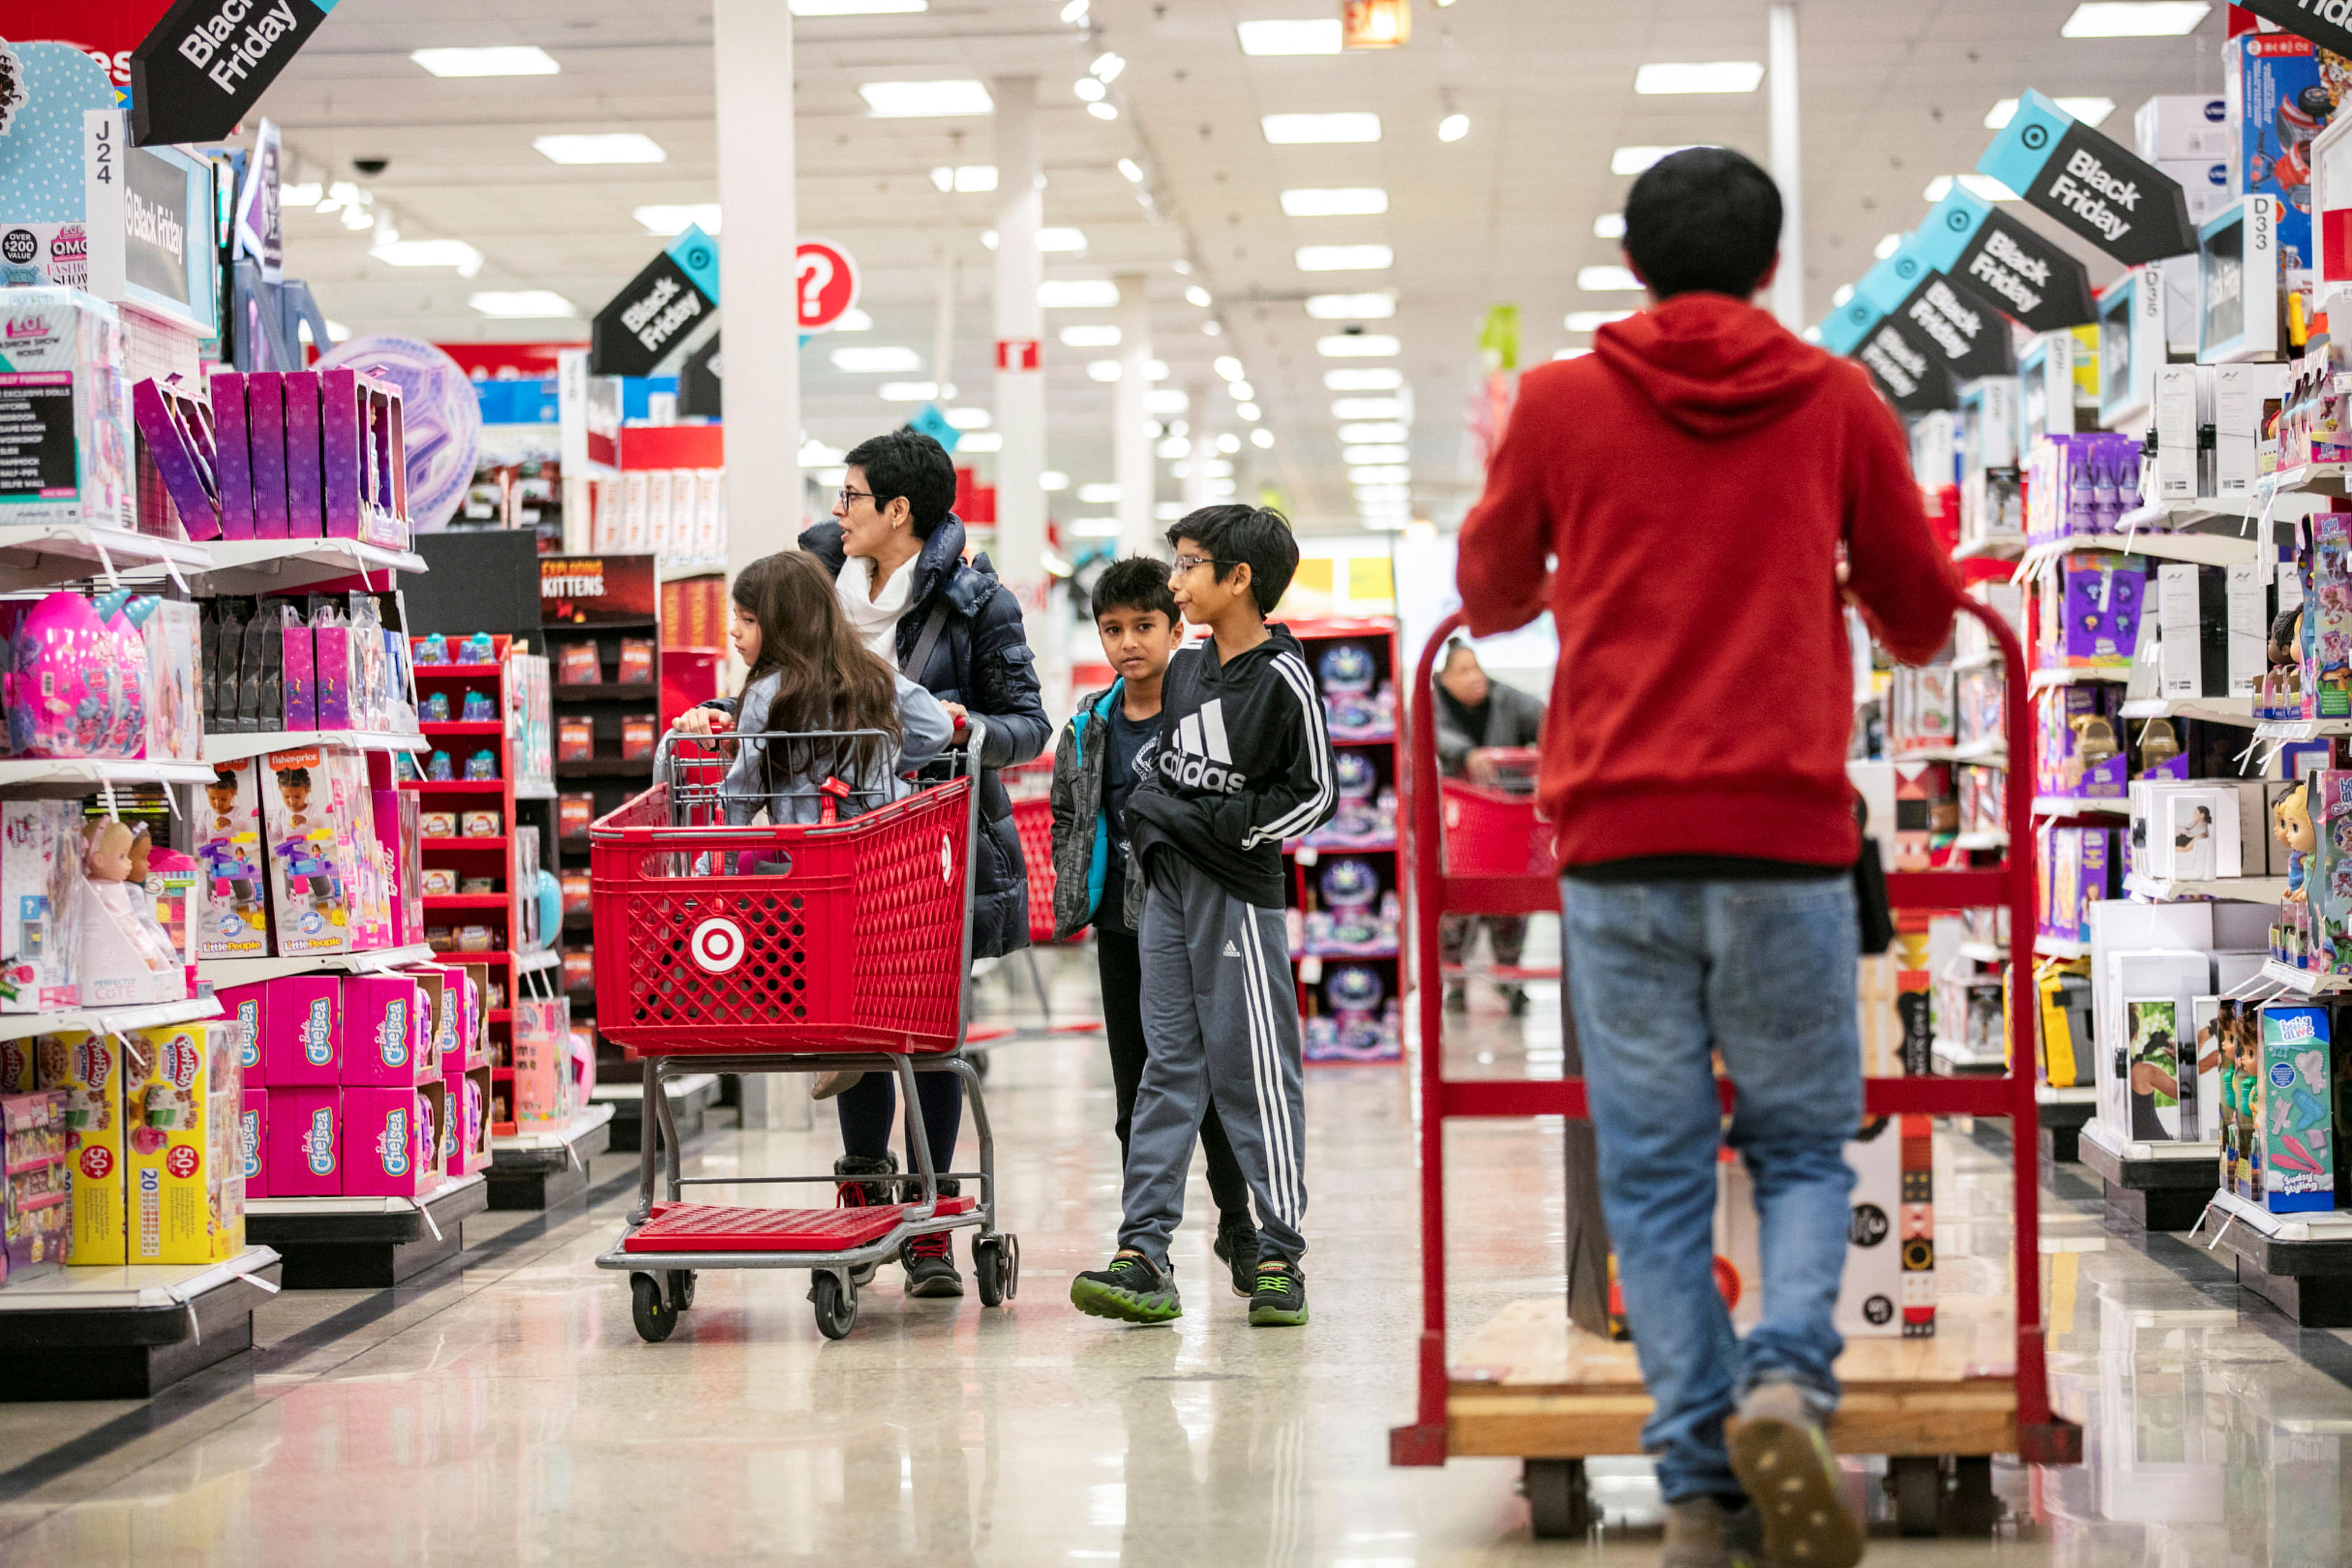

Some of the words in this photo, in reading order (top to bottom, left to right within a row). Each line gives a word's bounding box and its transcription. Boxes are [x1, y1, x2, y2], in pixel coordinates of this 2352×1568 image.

[208, 0, 297, 95] Friday
[2049, 174, 2132, 241] Friday
[2067, 148, 2142, 212] Black
[4, 241, 35, 252] $200
[133, 193, 157, 243] Black
[157, 204, 183, 265] Friday
[1984, 229, 2052, 290] Black
[621, 276, 681, 333] Black
[1925, 280, 1983, 339] Black
[1969, 252, 2043, 313] Friday
[638, 290, 702, 352] Friday
[541, 575, 604, 598] KITTENS
[1159, 748, 1247, 795] adidas
[309, 1002, 328, 1061] Chelsea
[385, 1004, 403, 1064] Chelsea
[311, 1111, 332, 1173] Chelsea
[385, 1112, 405, 1174] Chelsea
[141, 1170, 158, 1191] 20
